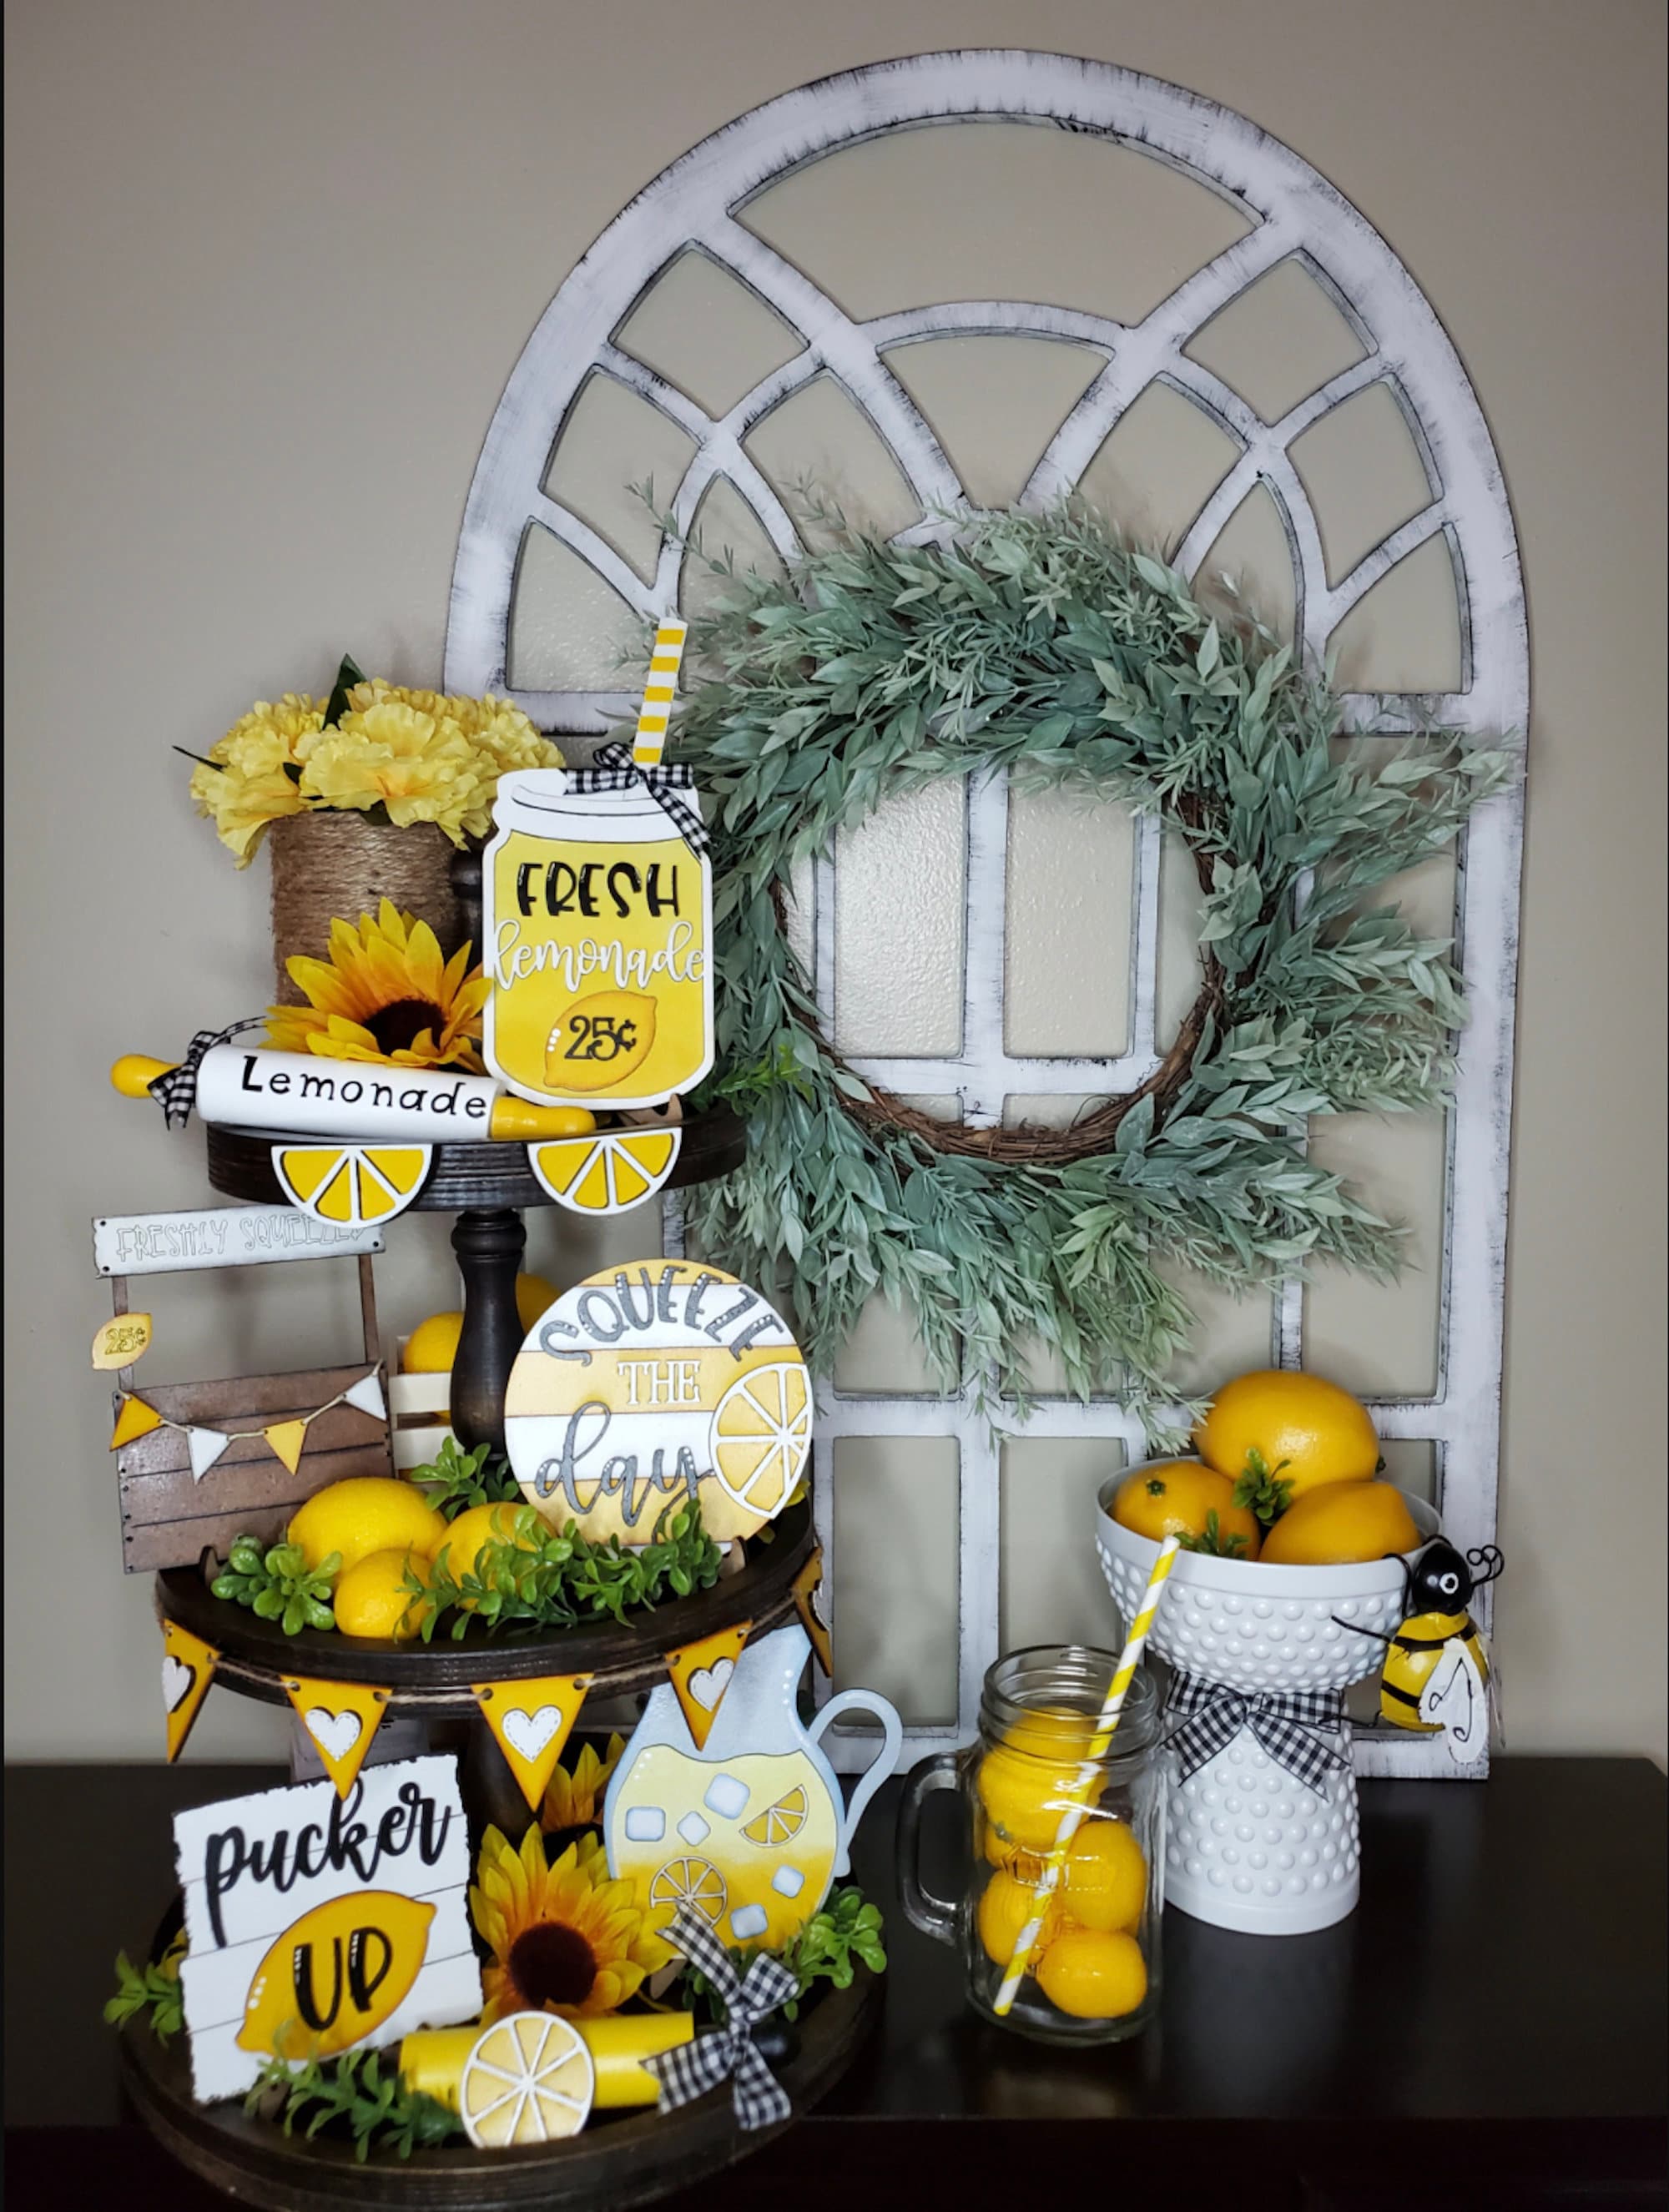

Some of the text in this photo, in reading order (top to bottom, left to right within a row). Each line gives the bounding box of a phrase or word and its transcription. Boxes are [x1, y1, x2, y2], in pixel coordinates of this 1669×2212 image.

[516, 861, 680, 918] FRESH
[492, 920, 706, 993] lemonade
[564, 1015, 637, 1061] 25¢
[242, 1055, 487, 1118] Lemonade
[116, 1220, 229, 1262] FRESHLY
[539, 1265, 784, 1367] SQUEEZE
[617, 1359, 702, 1405] THE
[534, 1401, 716, 1544] day
[204, 1776, 452, 1949] pucker
[294, 1926, 393, 2032] UP
